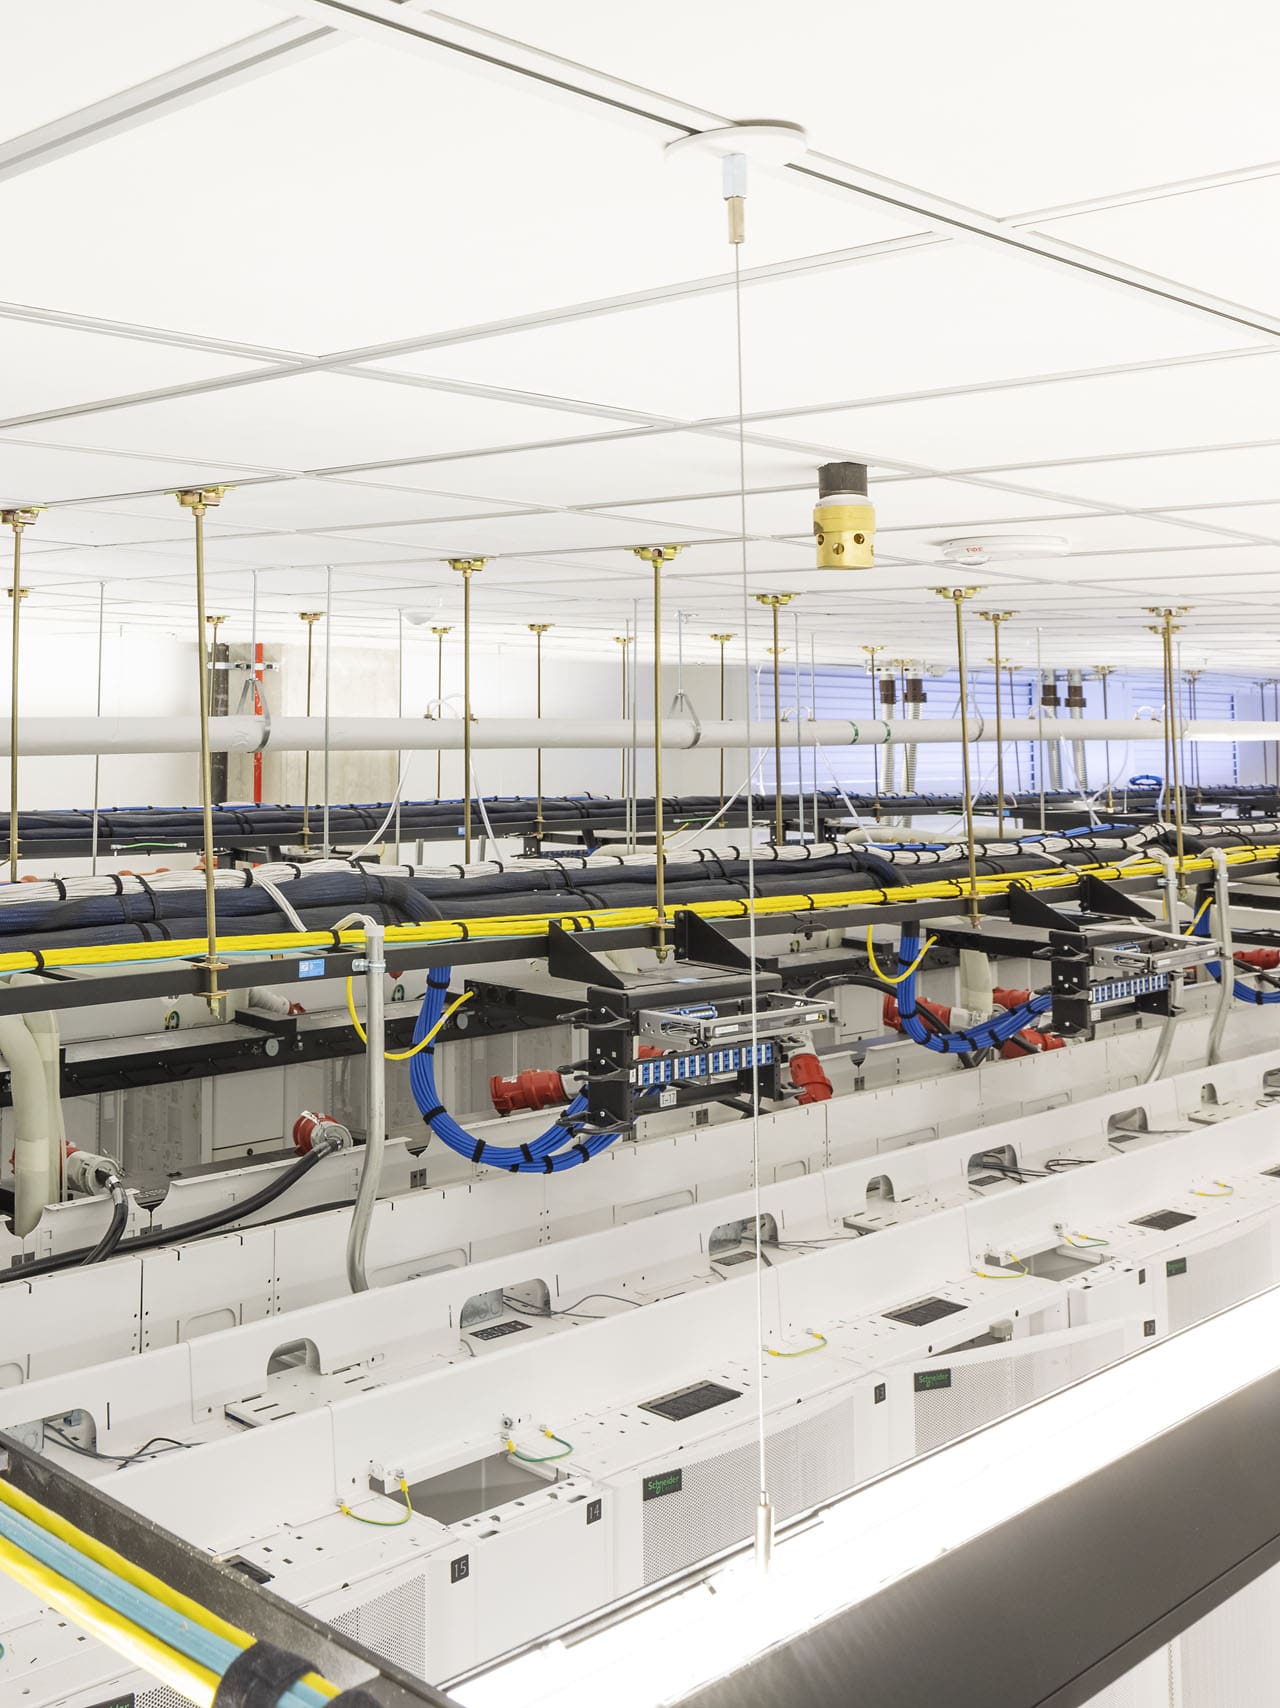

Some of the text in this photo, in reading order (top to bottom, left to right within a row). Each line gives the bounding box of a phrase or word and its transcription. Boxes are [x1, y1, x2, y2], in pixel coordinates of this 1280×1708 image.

[647, 1476, 680, 1494] Schneider
[589, 1504, 600, 1520] 14
[454, 1560, 467, 1578] 15
